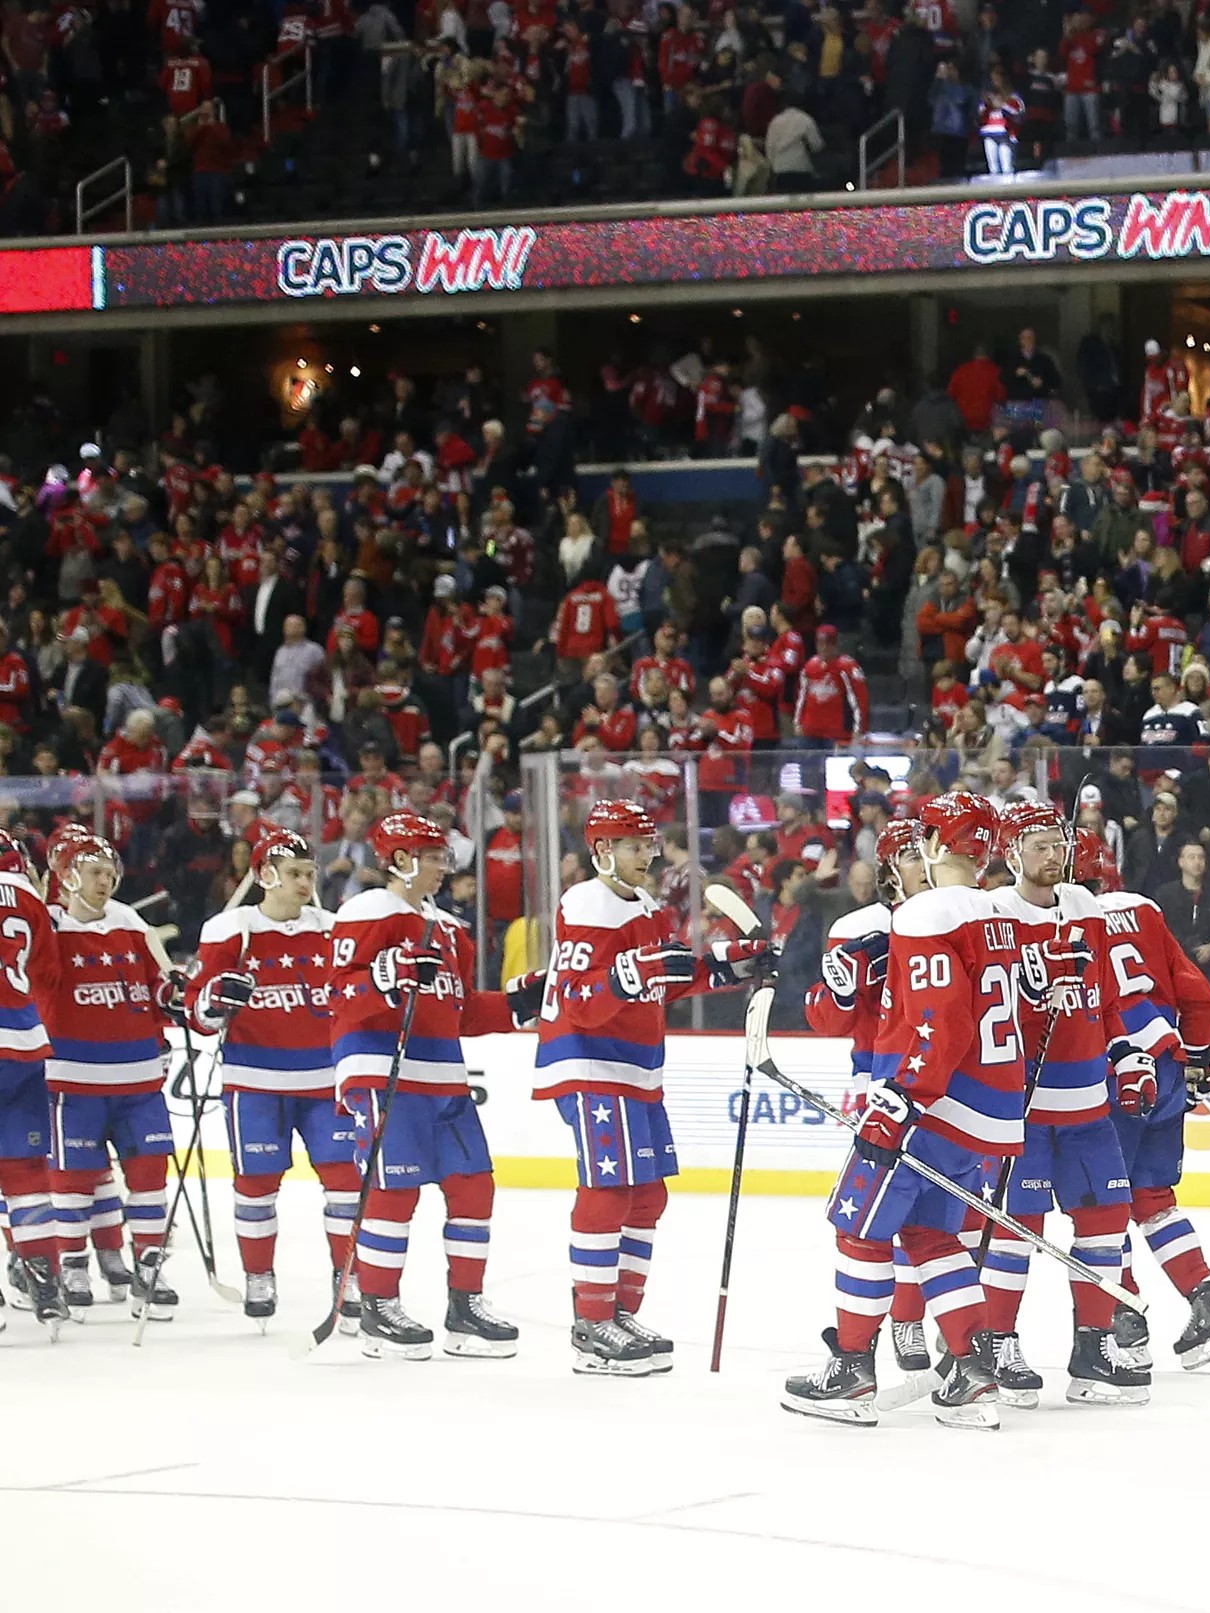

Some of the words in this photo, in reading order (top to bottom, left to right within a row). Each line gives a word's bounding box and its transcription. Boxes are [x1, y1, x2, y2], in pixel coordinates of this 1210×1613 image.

[963, 197, 1113, 264] CAPS
[276, 234, 413, 298] CAPS
[415, 225, 538, 294] WIN!
[975, 826, 990, 842] 20
[0, 915, 33, 995] 3
[332, 938, 356, 968] 19
[557, 940, 593, 972] 26
[908, 952, 952, 991] 20
[728, 1088, 826, 1125] CAPS
